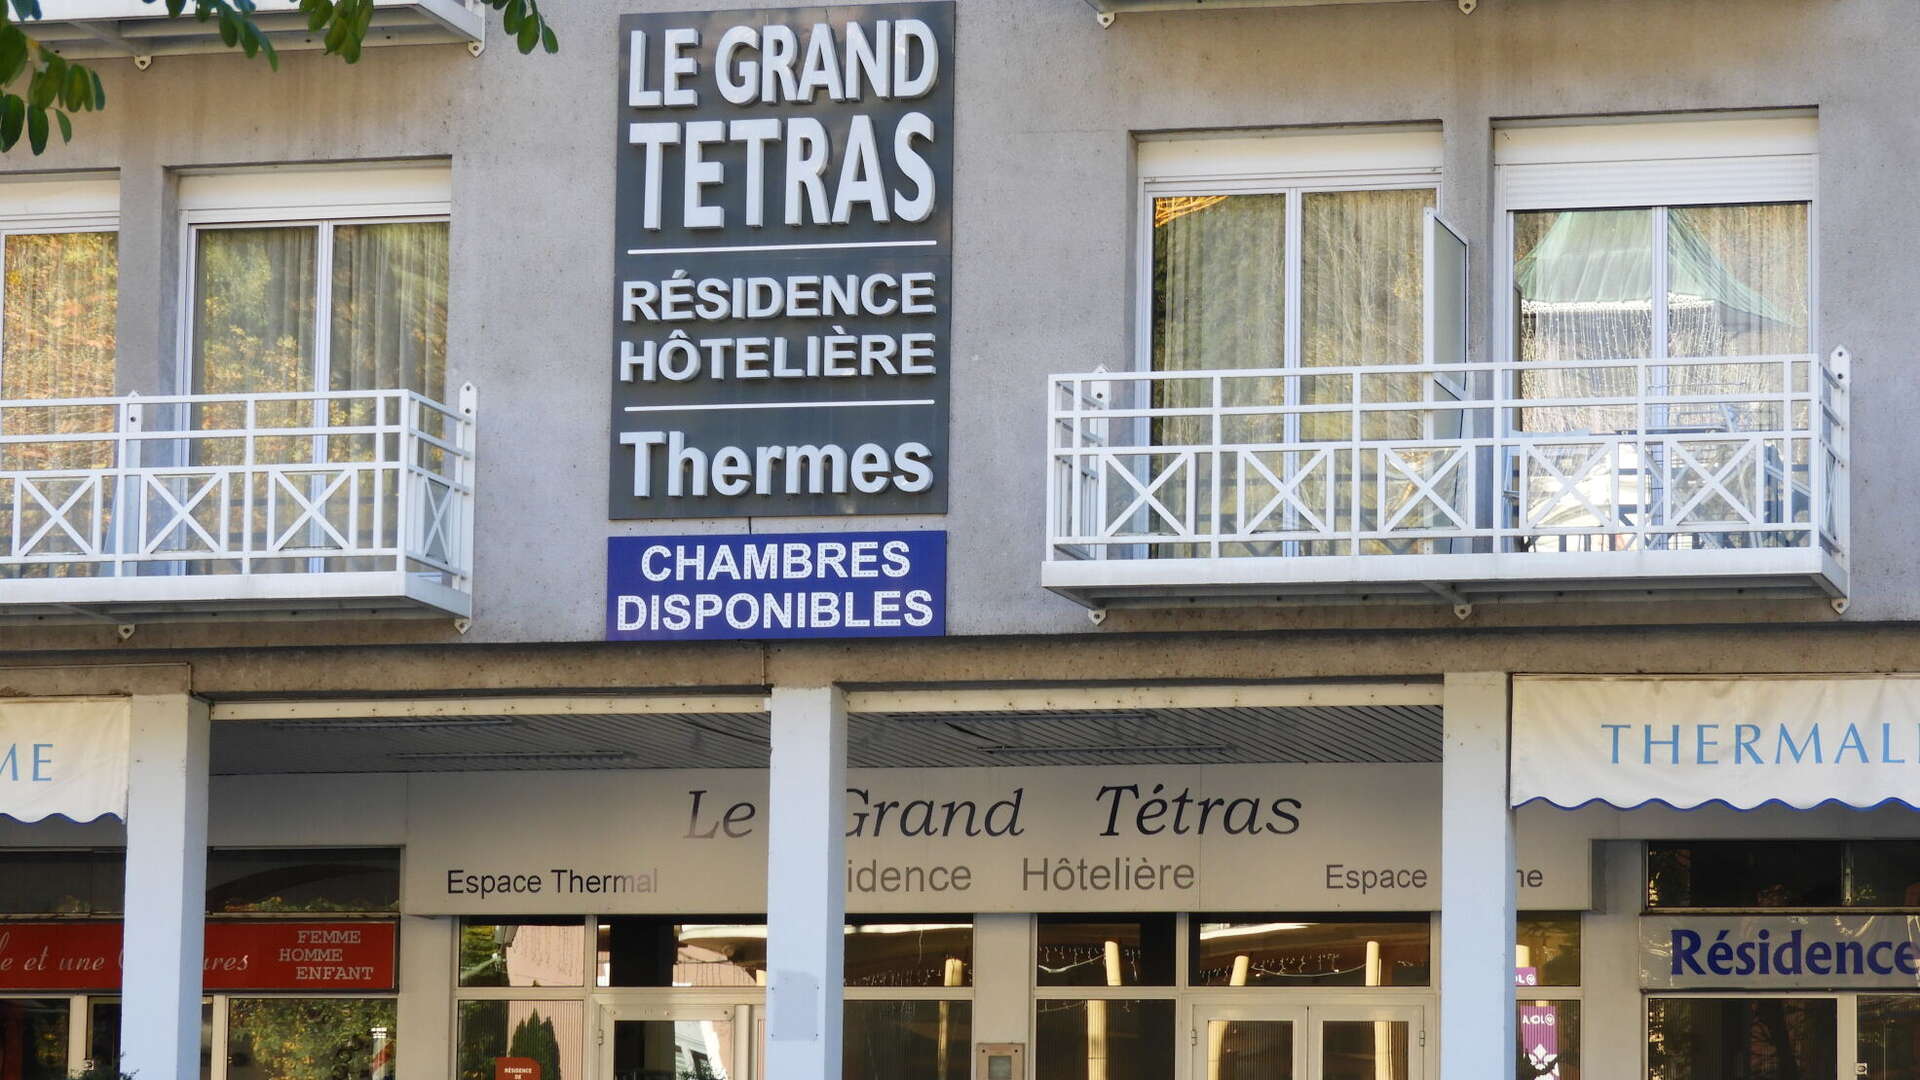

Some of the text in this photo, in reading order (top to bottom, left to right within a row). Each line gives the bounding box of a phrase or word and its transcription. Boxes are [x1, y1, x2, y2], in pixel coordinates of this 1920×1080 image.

[628, 19, 939, 107] LE GRAND
[628, 111, 936, 230] TETRAS
[622, 269, 937, 322] RÉSIDENCE
[620, 325, 937, 382] HÔTELIÈRE
[619, 431, 934, 497] Thermes
[641, 541, 911, 582] CHAMBRES
[617, 590, 934, 631] DISPONIBLES
[1600, 722, 1920, 765] THERMAL
[683, 789, 756, 839] Le
[1096, 783, 1302, 836] Tétras
[447, 867, 658, 899] Espace Thermal
[1022, 857, 1195, 891] Hôtelière
[1325, 863, 1428, 894] Espace
[278, 948, 344, 962] HOMME
[297, 930, 361, 944] FEMME
[1671, 928, 1920, 976] Résidence
[23, 945, 49, 971] et
[59, 956, 105, 971] une
[296, 966, 374, 980] ENFANT
